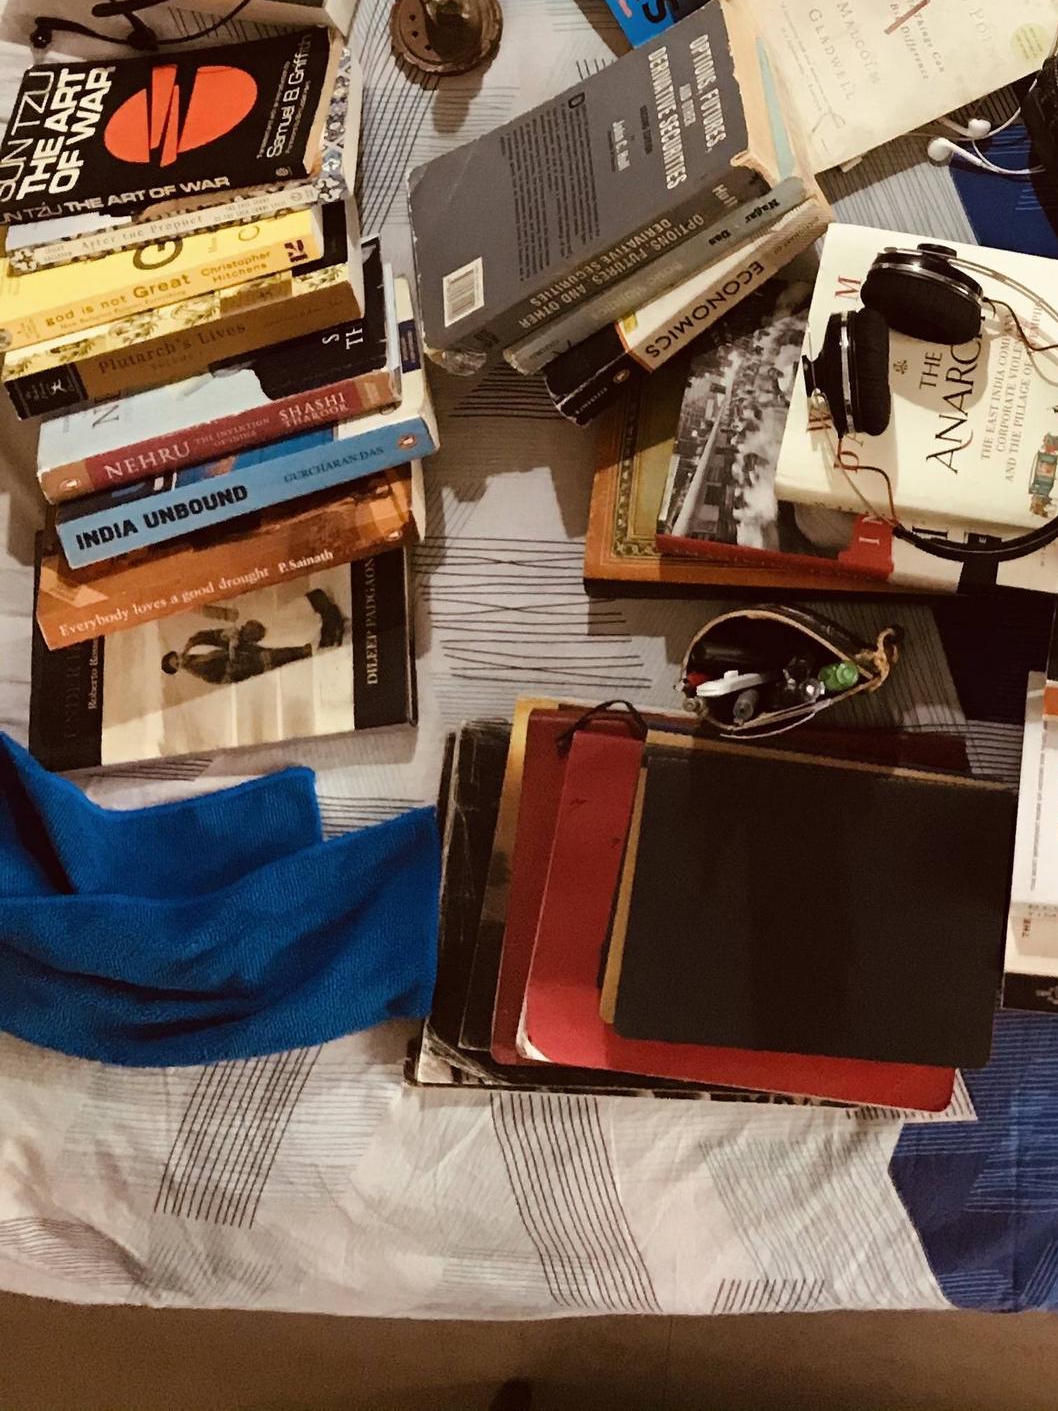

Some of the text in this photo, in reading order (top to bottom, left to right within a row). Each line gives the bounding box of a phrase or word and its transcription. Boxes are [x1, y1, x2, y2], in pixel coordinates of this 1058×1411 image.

[808, 8, 856, 100] GLADWELL
[11, 71, 54, 135] TZU
[48, 66, 116, 194] OF WAR
[16, 67, 85, 200] THE ART
[64, 176, 230, 212] THE ART OF WAR
[201, 250, 272, 277] Christopher
[212, 262, 268, 283] Hitchens
[46, 273, 191, 327] god is not Great
[645, 261, 765, 358] ECONOMICS
[199, 323, 247, 345] Lives
[919, 351, 943, 389] THE
[278, 392, 347, 420] SHASHI
[283, 402, 349, 429] THAROOR
[926, 339, 982, 475] ANARC
[104, 441, 192, 480] NEHRU
[75, 484, 249, 551] INDIA UNBOUND
[58, 567, 269, 639] Everybody loves good drought
